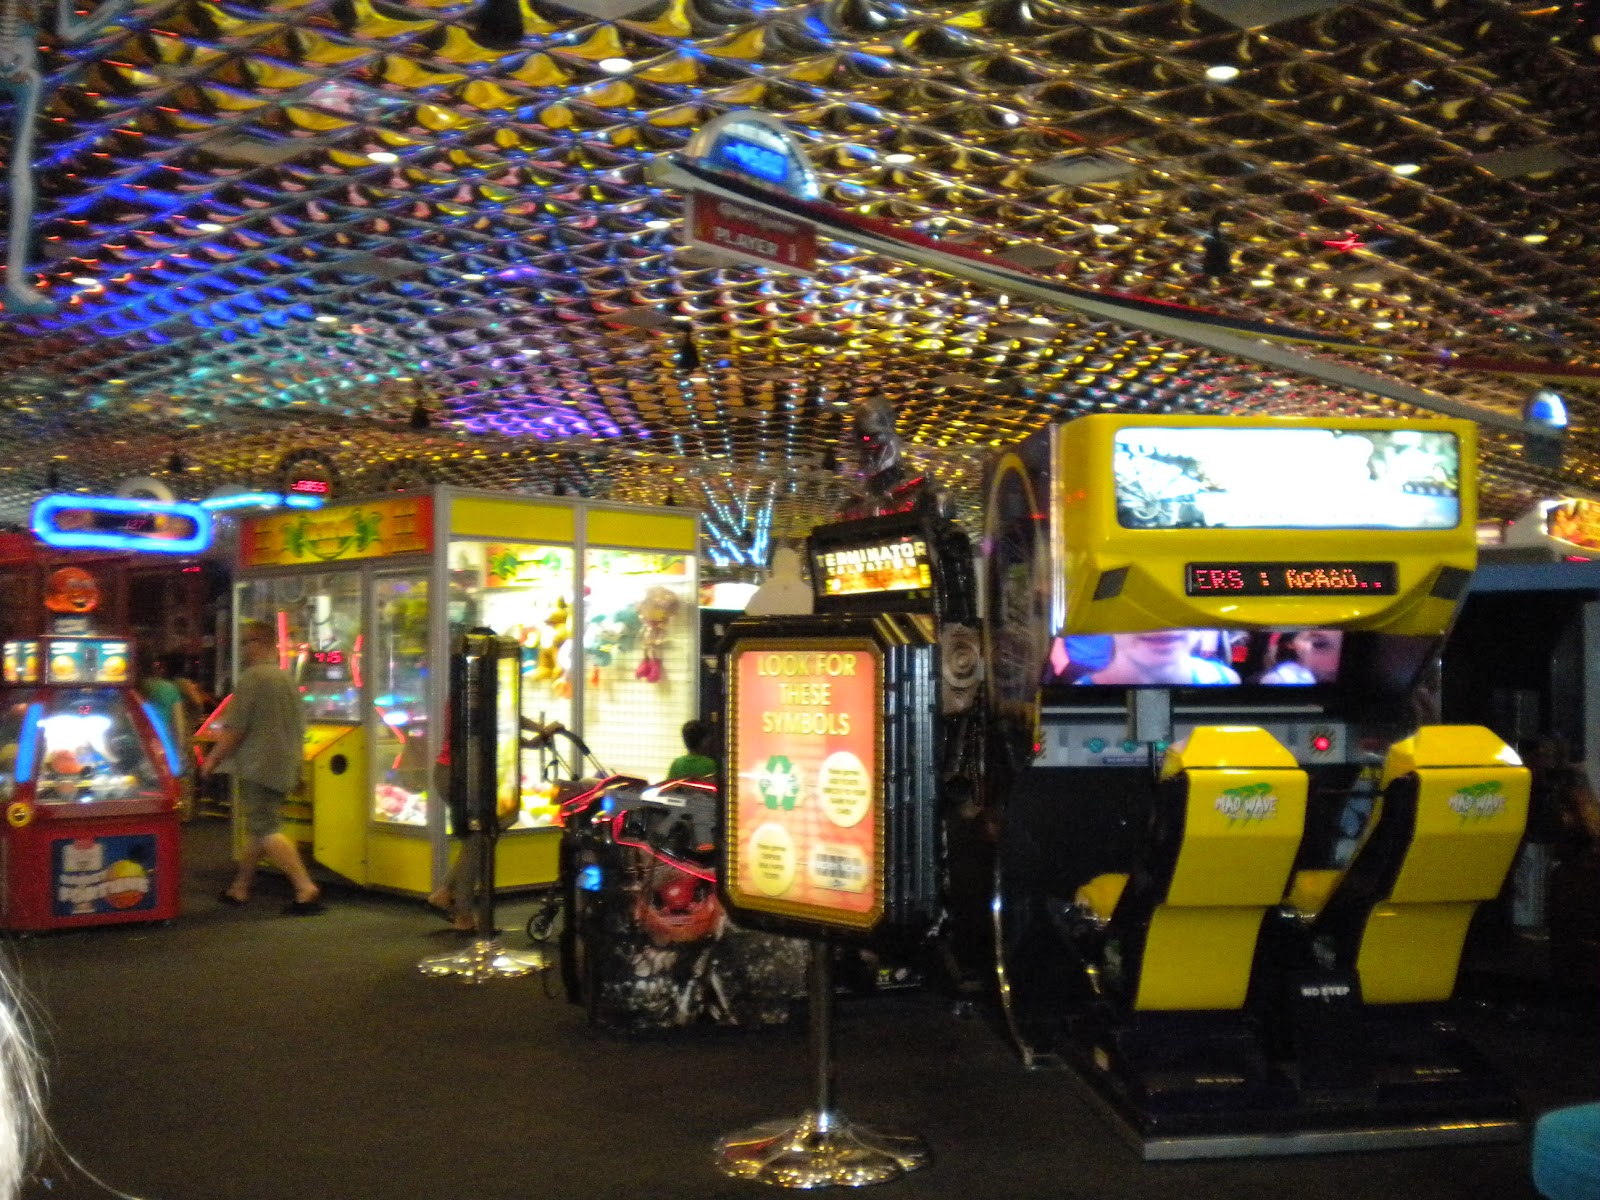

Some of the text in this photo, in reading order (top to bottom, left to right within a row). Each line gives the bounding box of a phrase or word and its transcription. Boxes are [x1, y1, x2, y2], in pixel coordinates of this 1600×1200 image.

[713, 226, 778, 257] PLAYER
[816, 541, 927, 567] TERMINATOR
[1195, 569, 1245, 590] ERS
[757, 653, 857, 677] LOOK FOR
[779, 683, 832, 706] THESE
[761, 711, 851, 736] SYMBOLS
[1244, 795, 1278, 814] WAVE
[1475, 794, 1507, 811] WAVE
